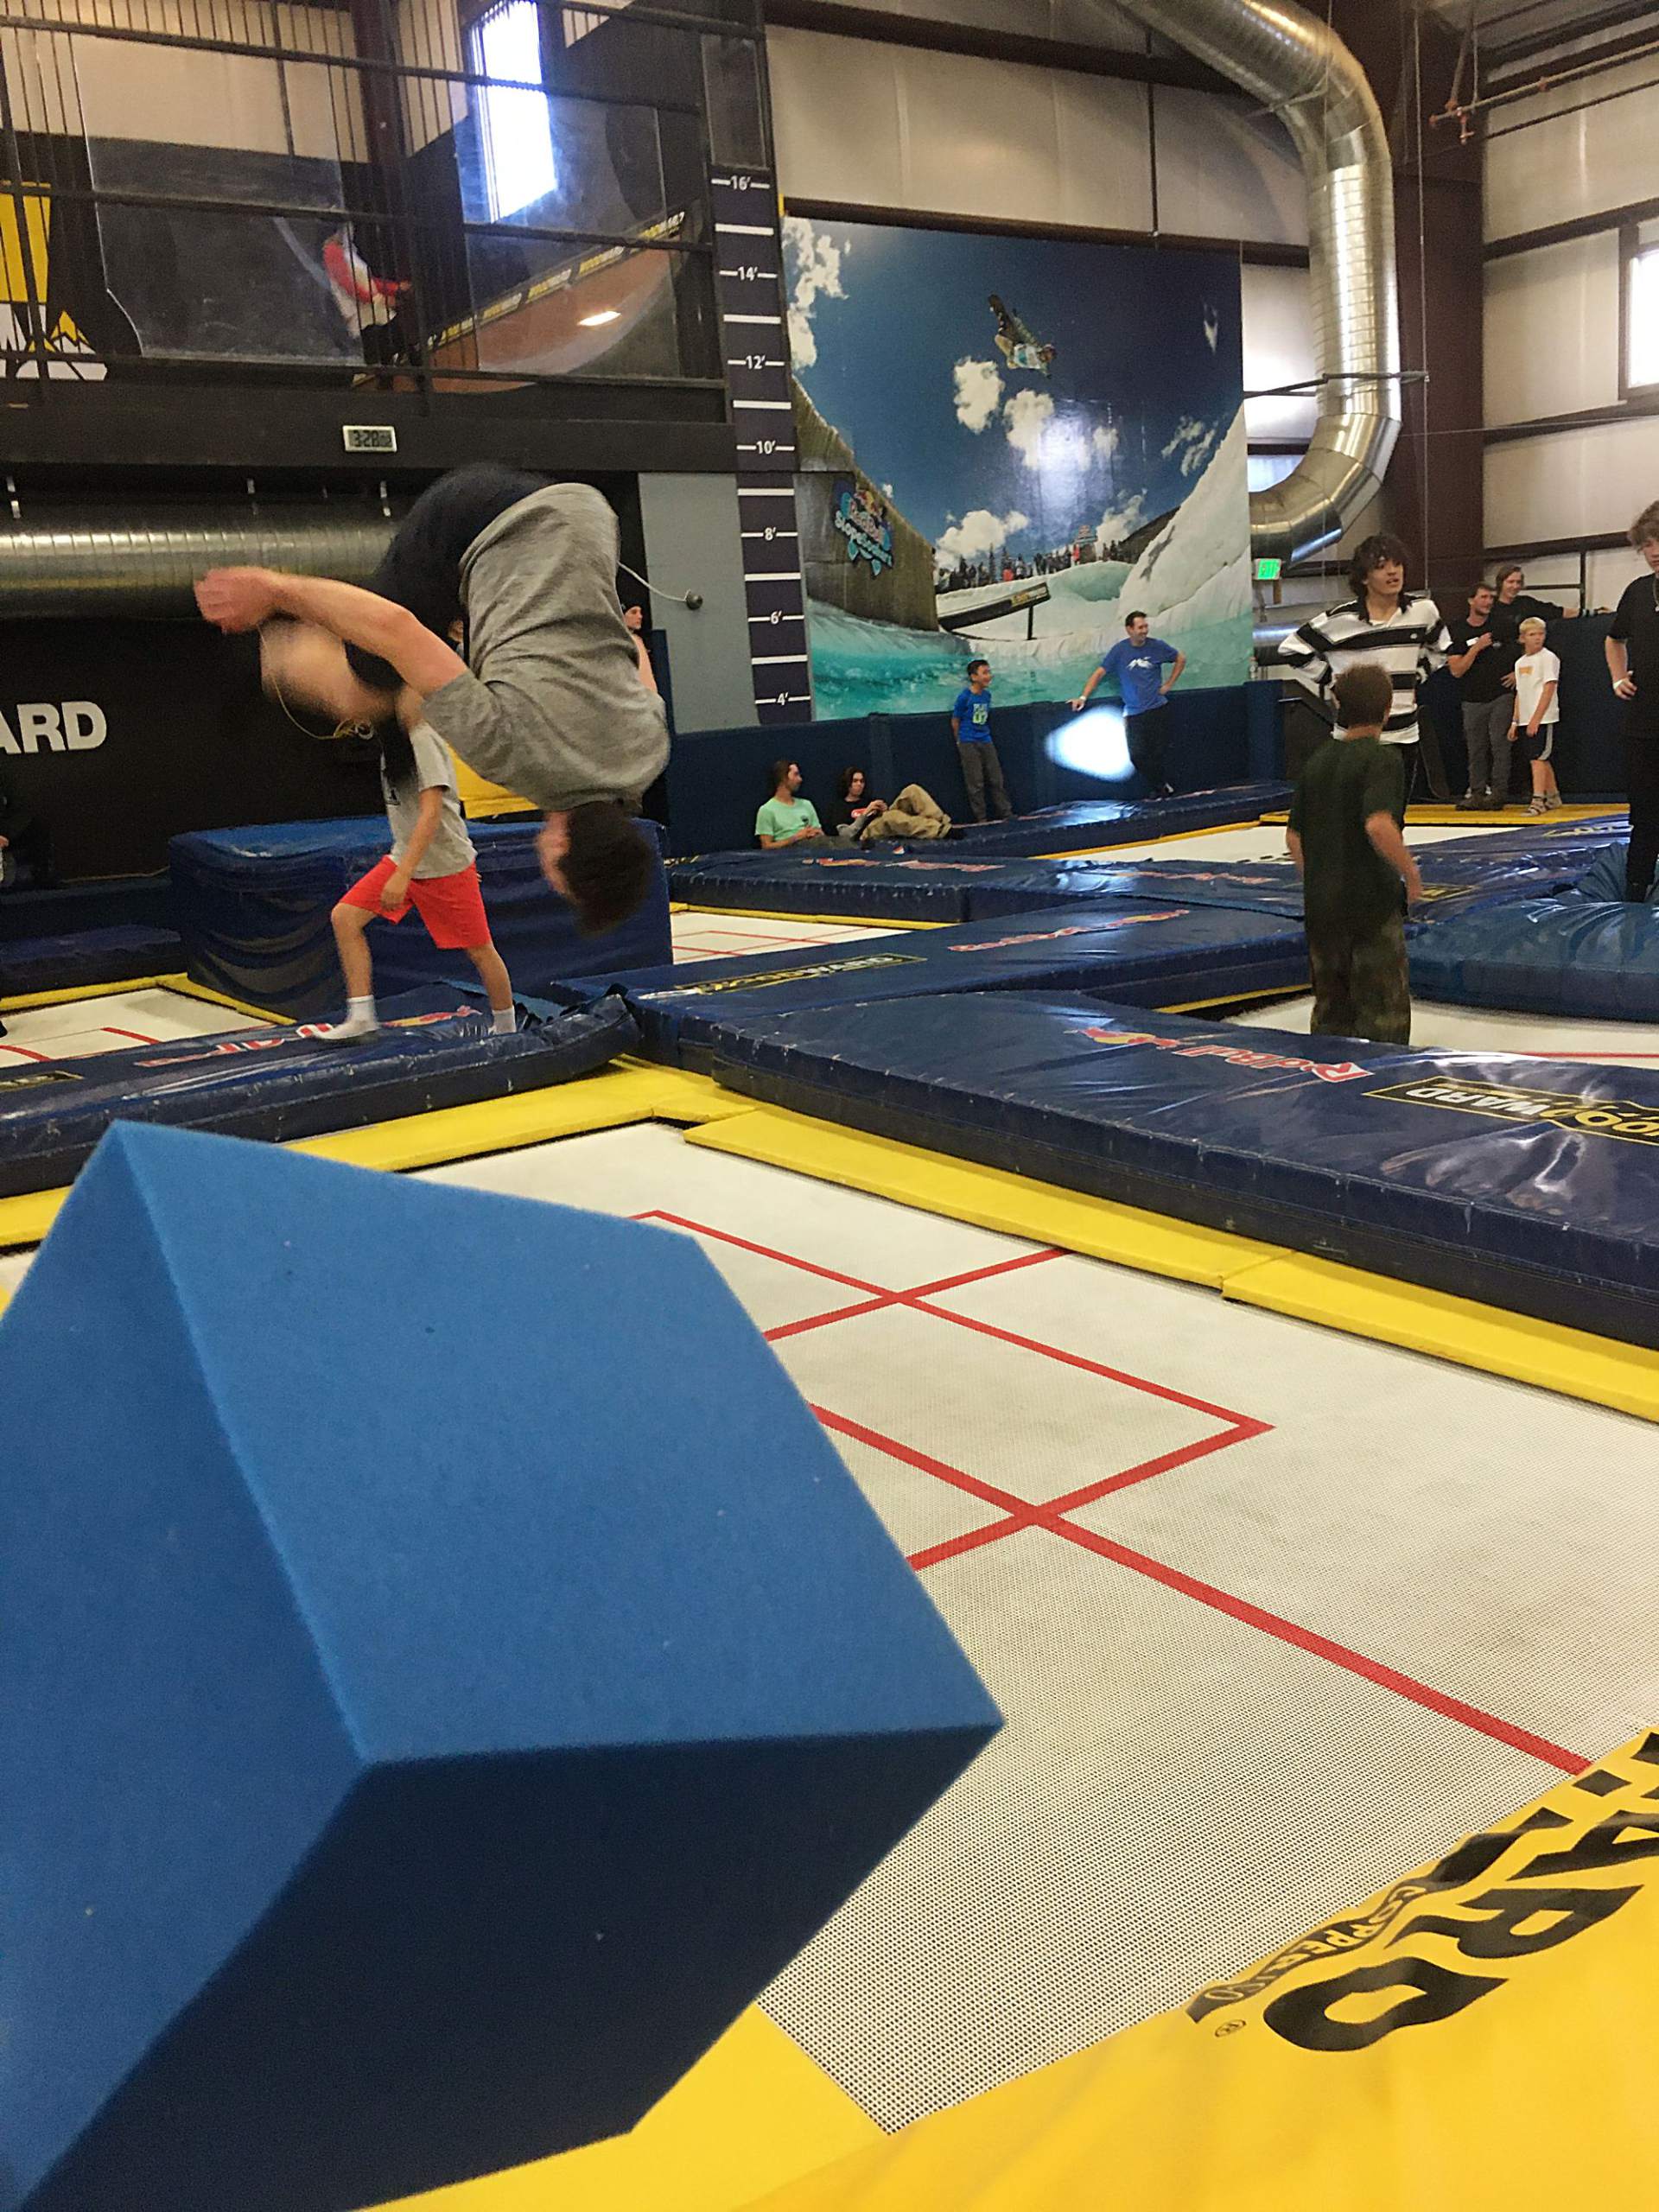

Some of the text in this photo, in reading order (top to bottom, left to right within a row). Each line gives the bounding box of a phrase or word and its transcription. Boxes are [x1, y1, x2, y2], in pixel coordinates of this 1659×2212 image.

[738, 266, 758, 281] 14'
[746, 354, 766, 369] 12'
[757, 440, 776, 454] 10'
[1406, 1087, 1659, 1137] OODWARD
[1263, 1785, 1659, 2051] ARD
